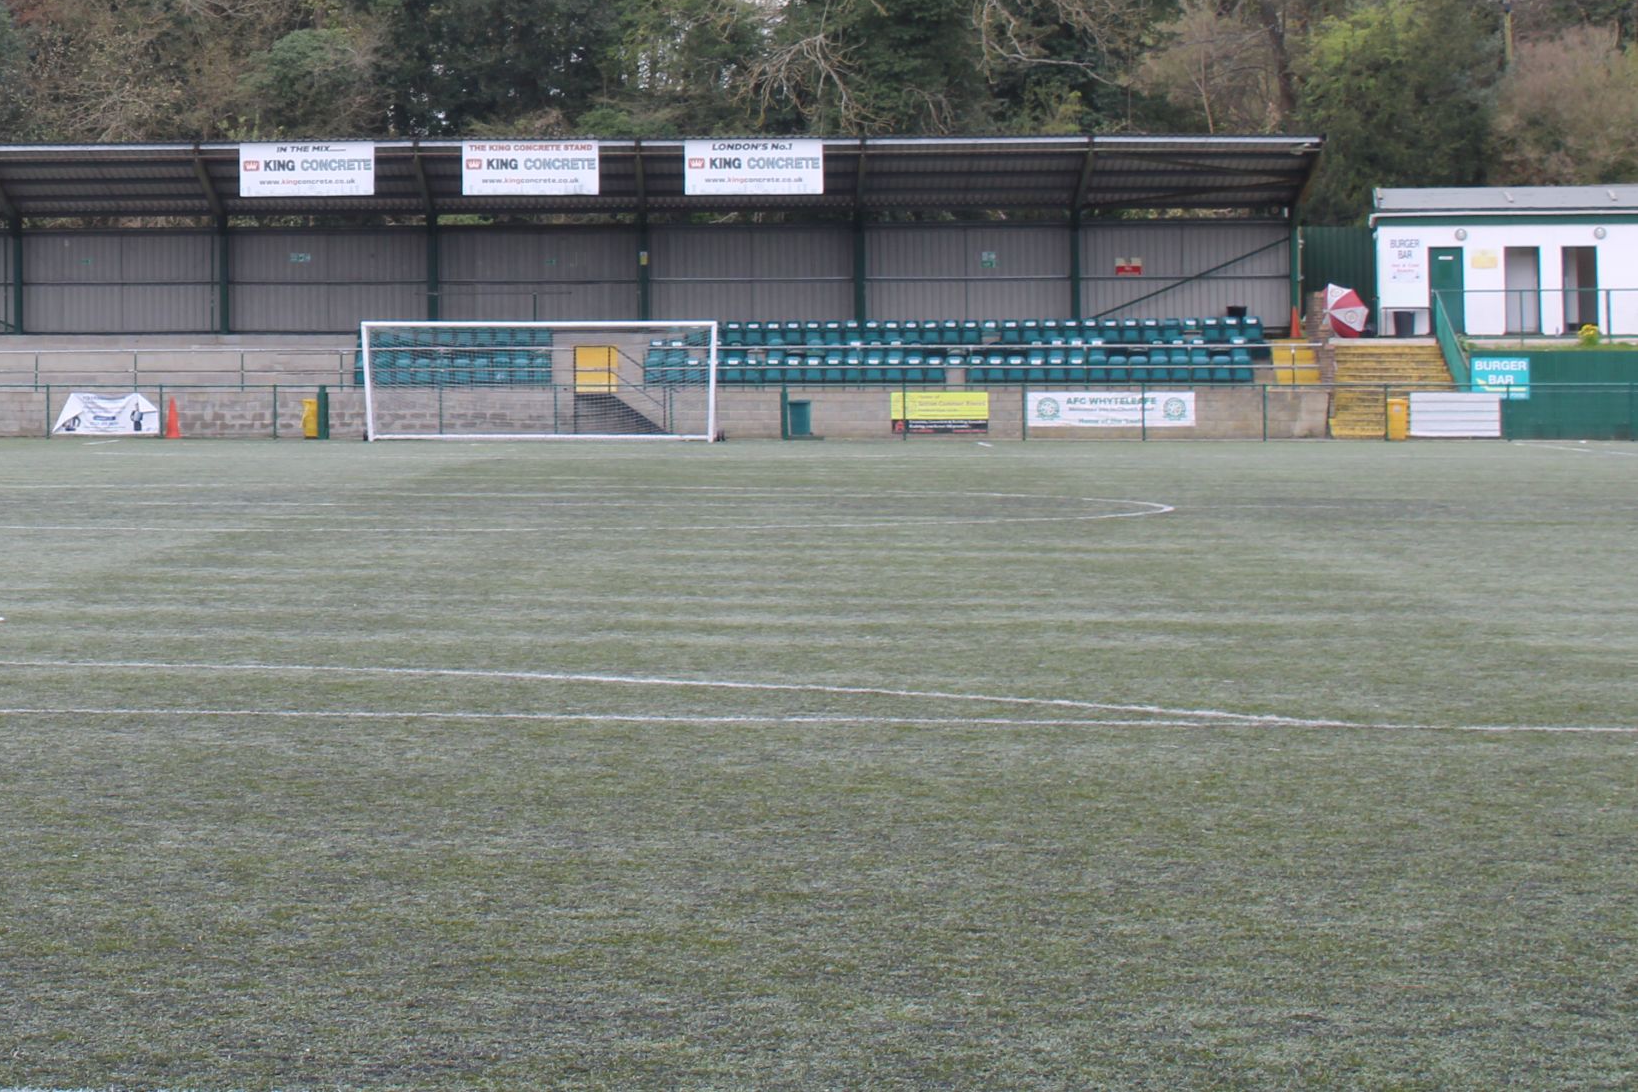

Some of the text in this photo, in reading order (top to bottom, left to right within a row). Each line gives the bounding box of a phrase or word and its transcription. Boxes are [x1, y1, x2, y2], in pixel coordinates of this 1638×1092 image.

[712, 143, 768, 151] LONDON'S
[263, 158, 372, 171] KING CONCRETE
[486, 158, 596, 170] KING CONCRETE
[709, 157, 820, 169] KING CONCRETE
[259, 178, 355, 186] www.kingconcrete.co.uk
[1390, 239, 1420, 248] BURGER
[1398, 250, 1412, 259] BAR
[1475, 360, 1527, 370] BURGER
[1488, 374, 1514, 384] BAR
[1066, 397, 1086, 405] AFC
